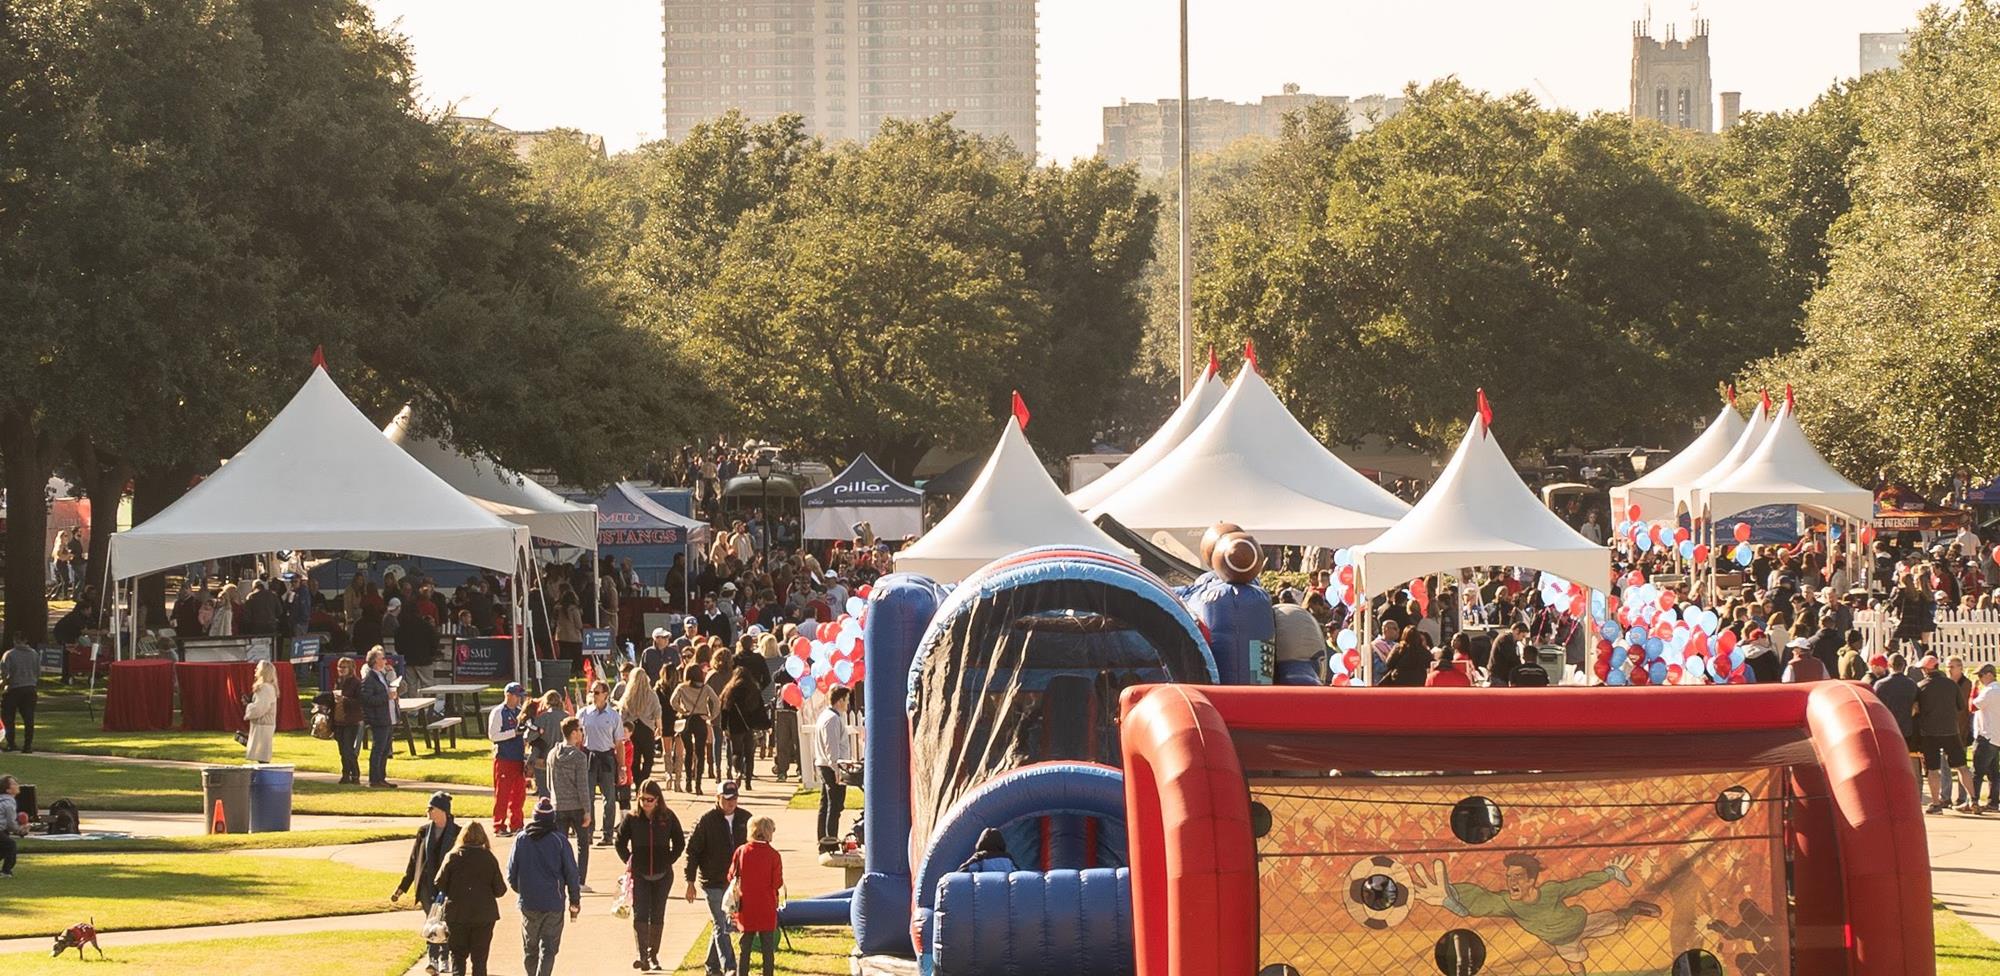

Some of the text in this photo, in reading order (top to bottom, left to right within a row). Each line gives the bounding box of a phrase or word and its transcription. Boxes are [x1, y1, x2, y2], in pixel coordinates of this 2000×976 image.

[834, 481, 890, 494] pillar
[598, 512, 639, 523] MU
[598, 529, 677, 544] STANGS
[470, 648, 491, 658] SMU
